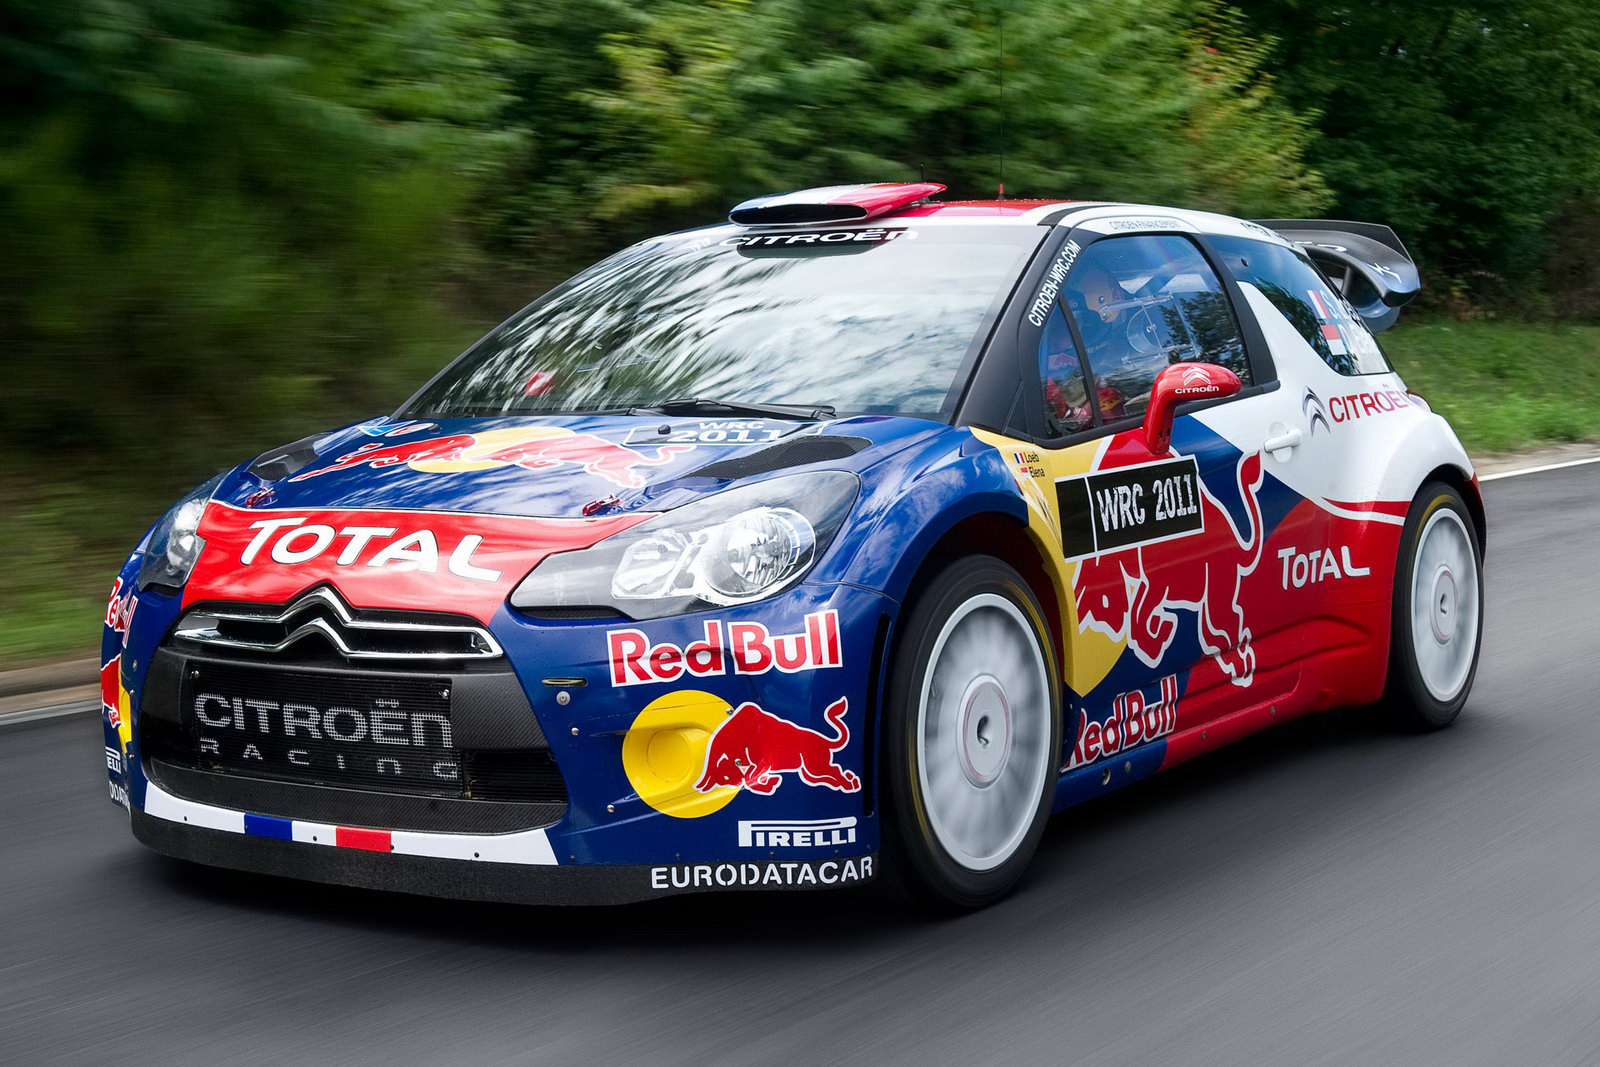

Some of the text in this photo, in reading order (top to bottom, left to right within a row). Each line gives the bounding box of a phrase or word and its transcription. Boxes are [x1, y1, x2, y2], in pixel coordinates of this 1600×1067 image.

[1028, 239, 1081, 328] CITROEN-WRC.COM
[667, 429, 782, 443] 2011
[699, 421, 765, 431] WRC
[1024, 451, 1040, 464] Loeb
[1029, 467, 1046, 478] Elena
[1096, 474, 1198, 532] WRC 2011
[240, 516, 503, 583] TOTAL
[1277, 545, 1371, 591] TOTAL
[606, 608, 843, 688] Red Bull
[1122, 673, 1178, 751] Bull
[738, 816, 857, 847] PIRELLI
[651, 856, 873, 889] EURODATACAR
